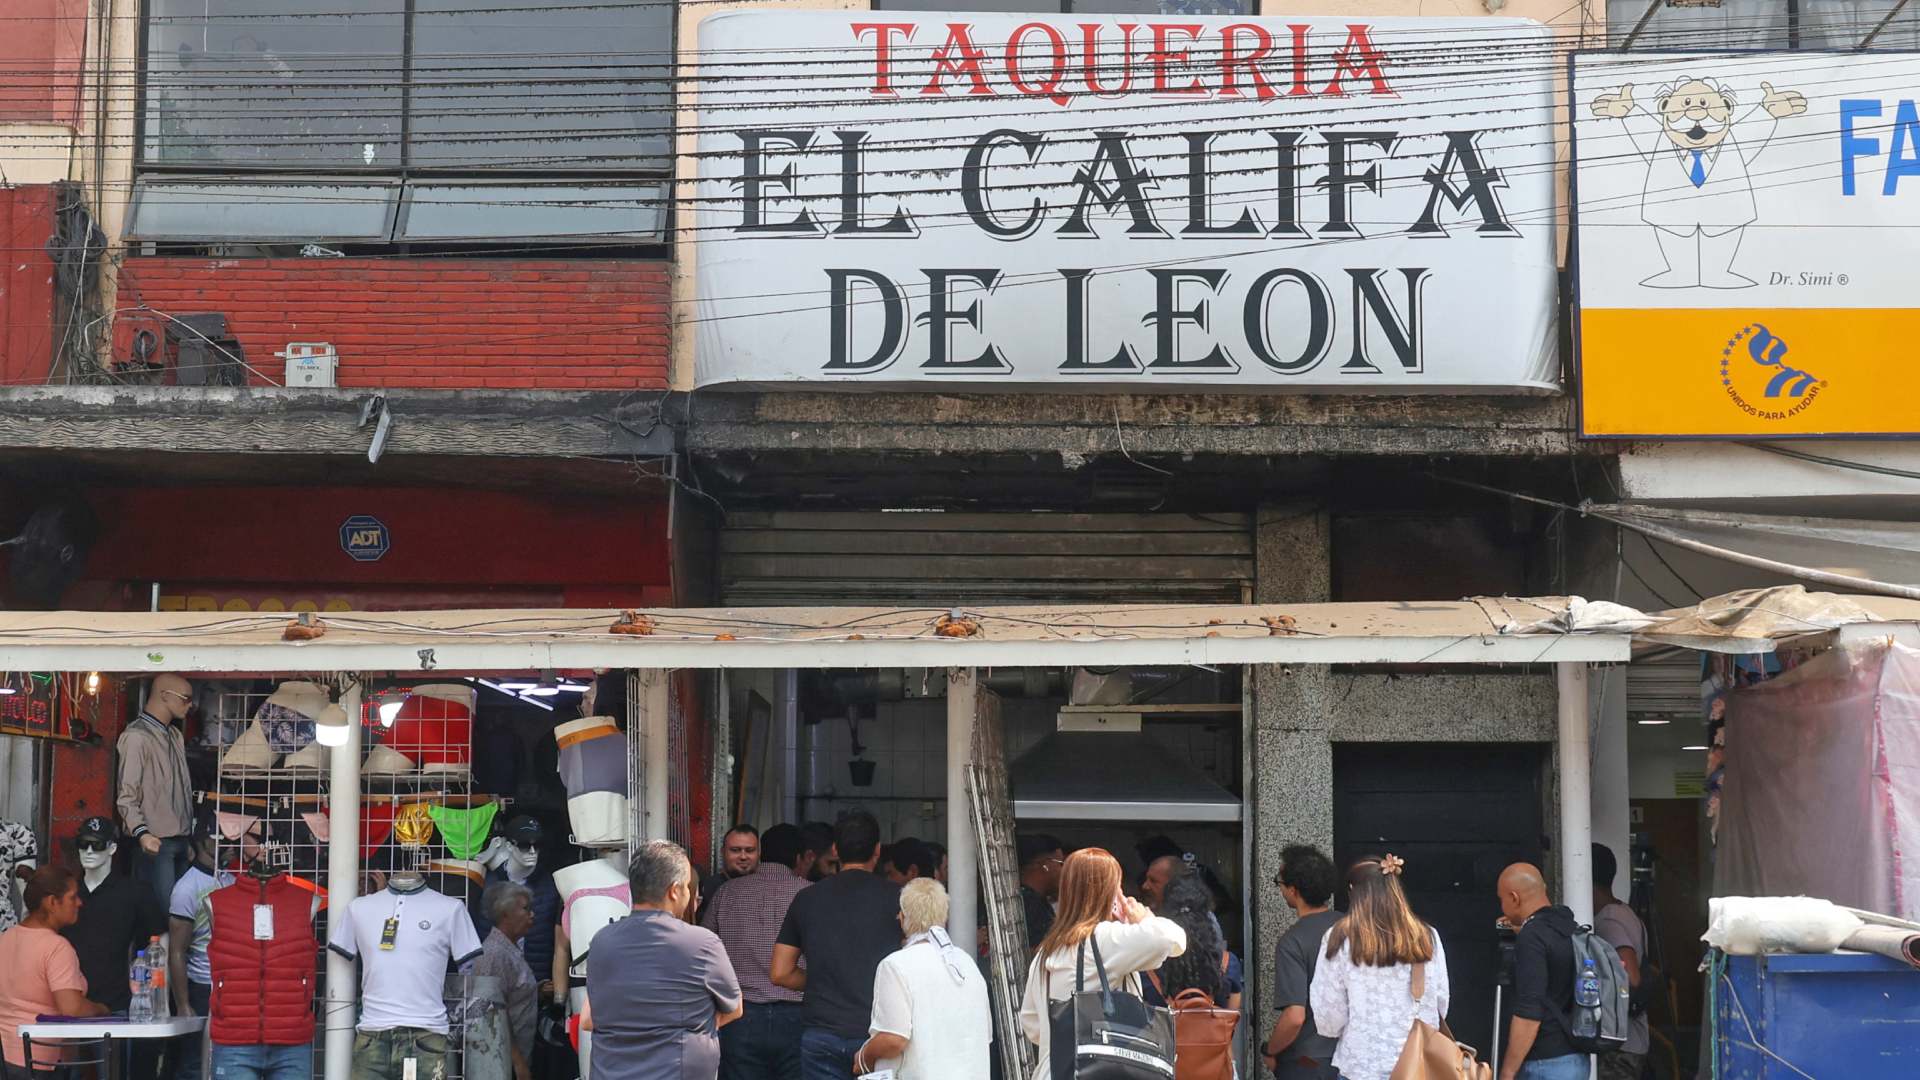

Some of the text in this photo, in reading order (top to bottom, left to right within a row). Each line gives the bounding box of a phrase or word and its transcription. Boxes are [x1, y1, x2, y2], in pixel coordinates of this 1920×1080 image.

[851, 23, 1402, 107] TAQUERIA
[729, 128, 1523, 242] EL CALIFA
[1768, 271, 1794, 286] Dr.
[1798, 271, 1834, 286] Simi
[821, 266, 1433, 376] DE LEON
[1726, 386, 1820, 420] UNIDOS PARA AYUDAR
[350, 530, 381, 546] ADT
